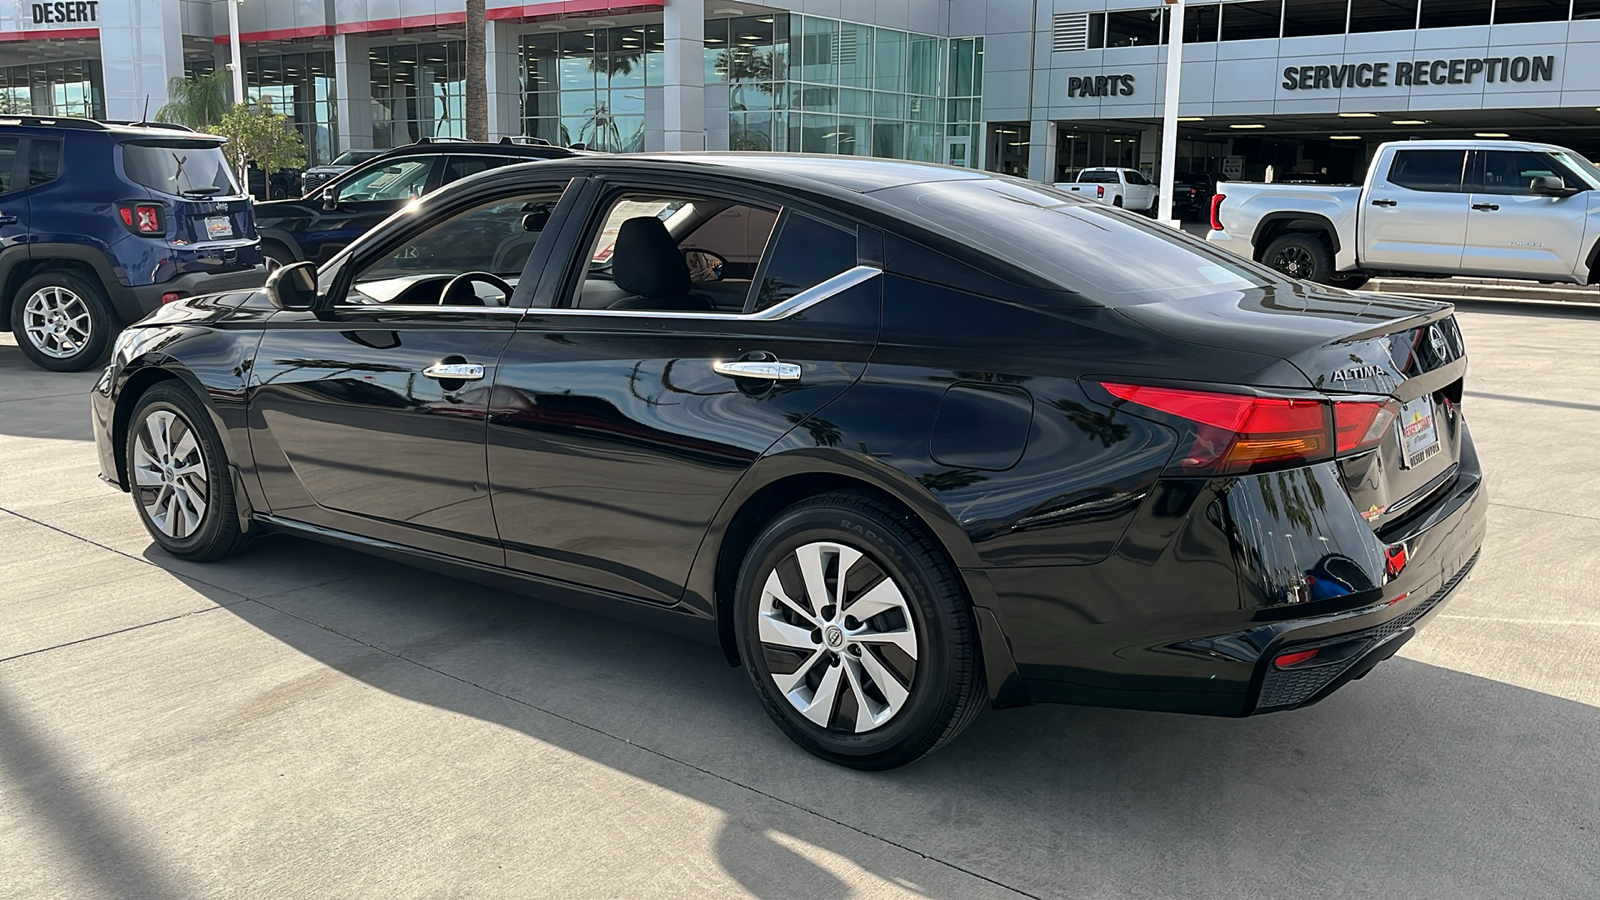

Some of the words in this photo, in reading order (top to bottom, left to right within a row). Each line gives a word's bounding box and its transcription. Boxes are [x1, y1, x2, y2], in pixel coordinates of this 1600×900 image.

[32, 1, 98, 24] DESERT
[1282, 62, 1388, 90] SERVICE
[1394, 55, 1554, 86] RECEPTION
[1067, 74, 1135, 98] PARTS
[1333, 365, 1385, 382] ALTIMA
[1409, 450, 1425, 468] DESERT
